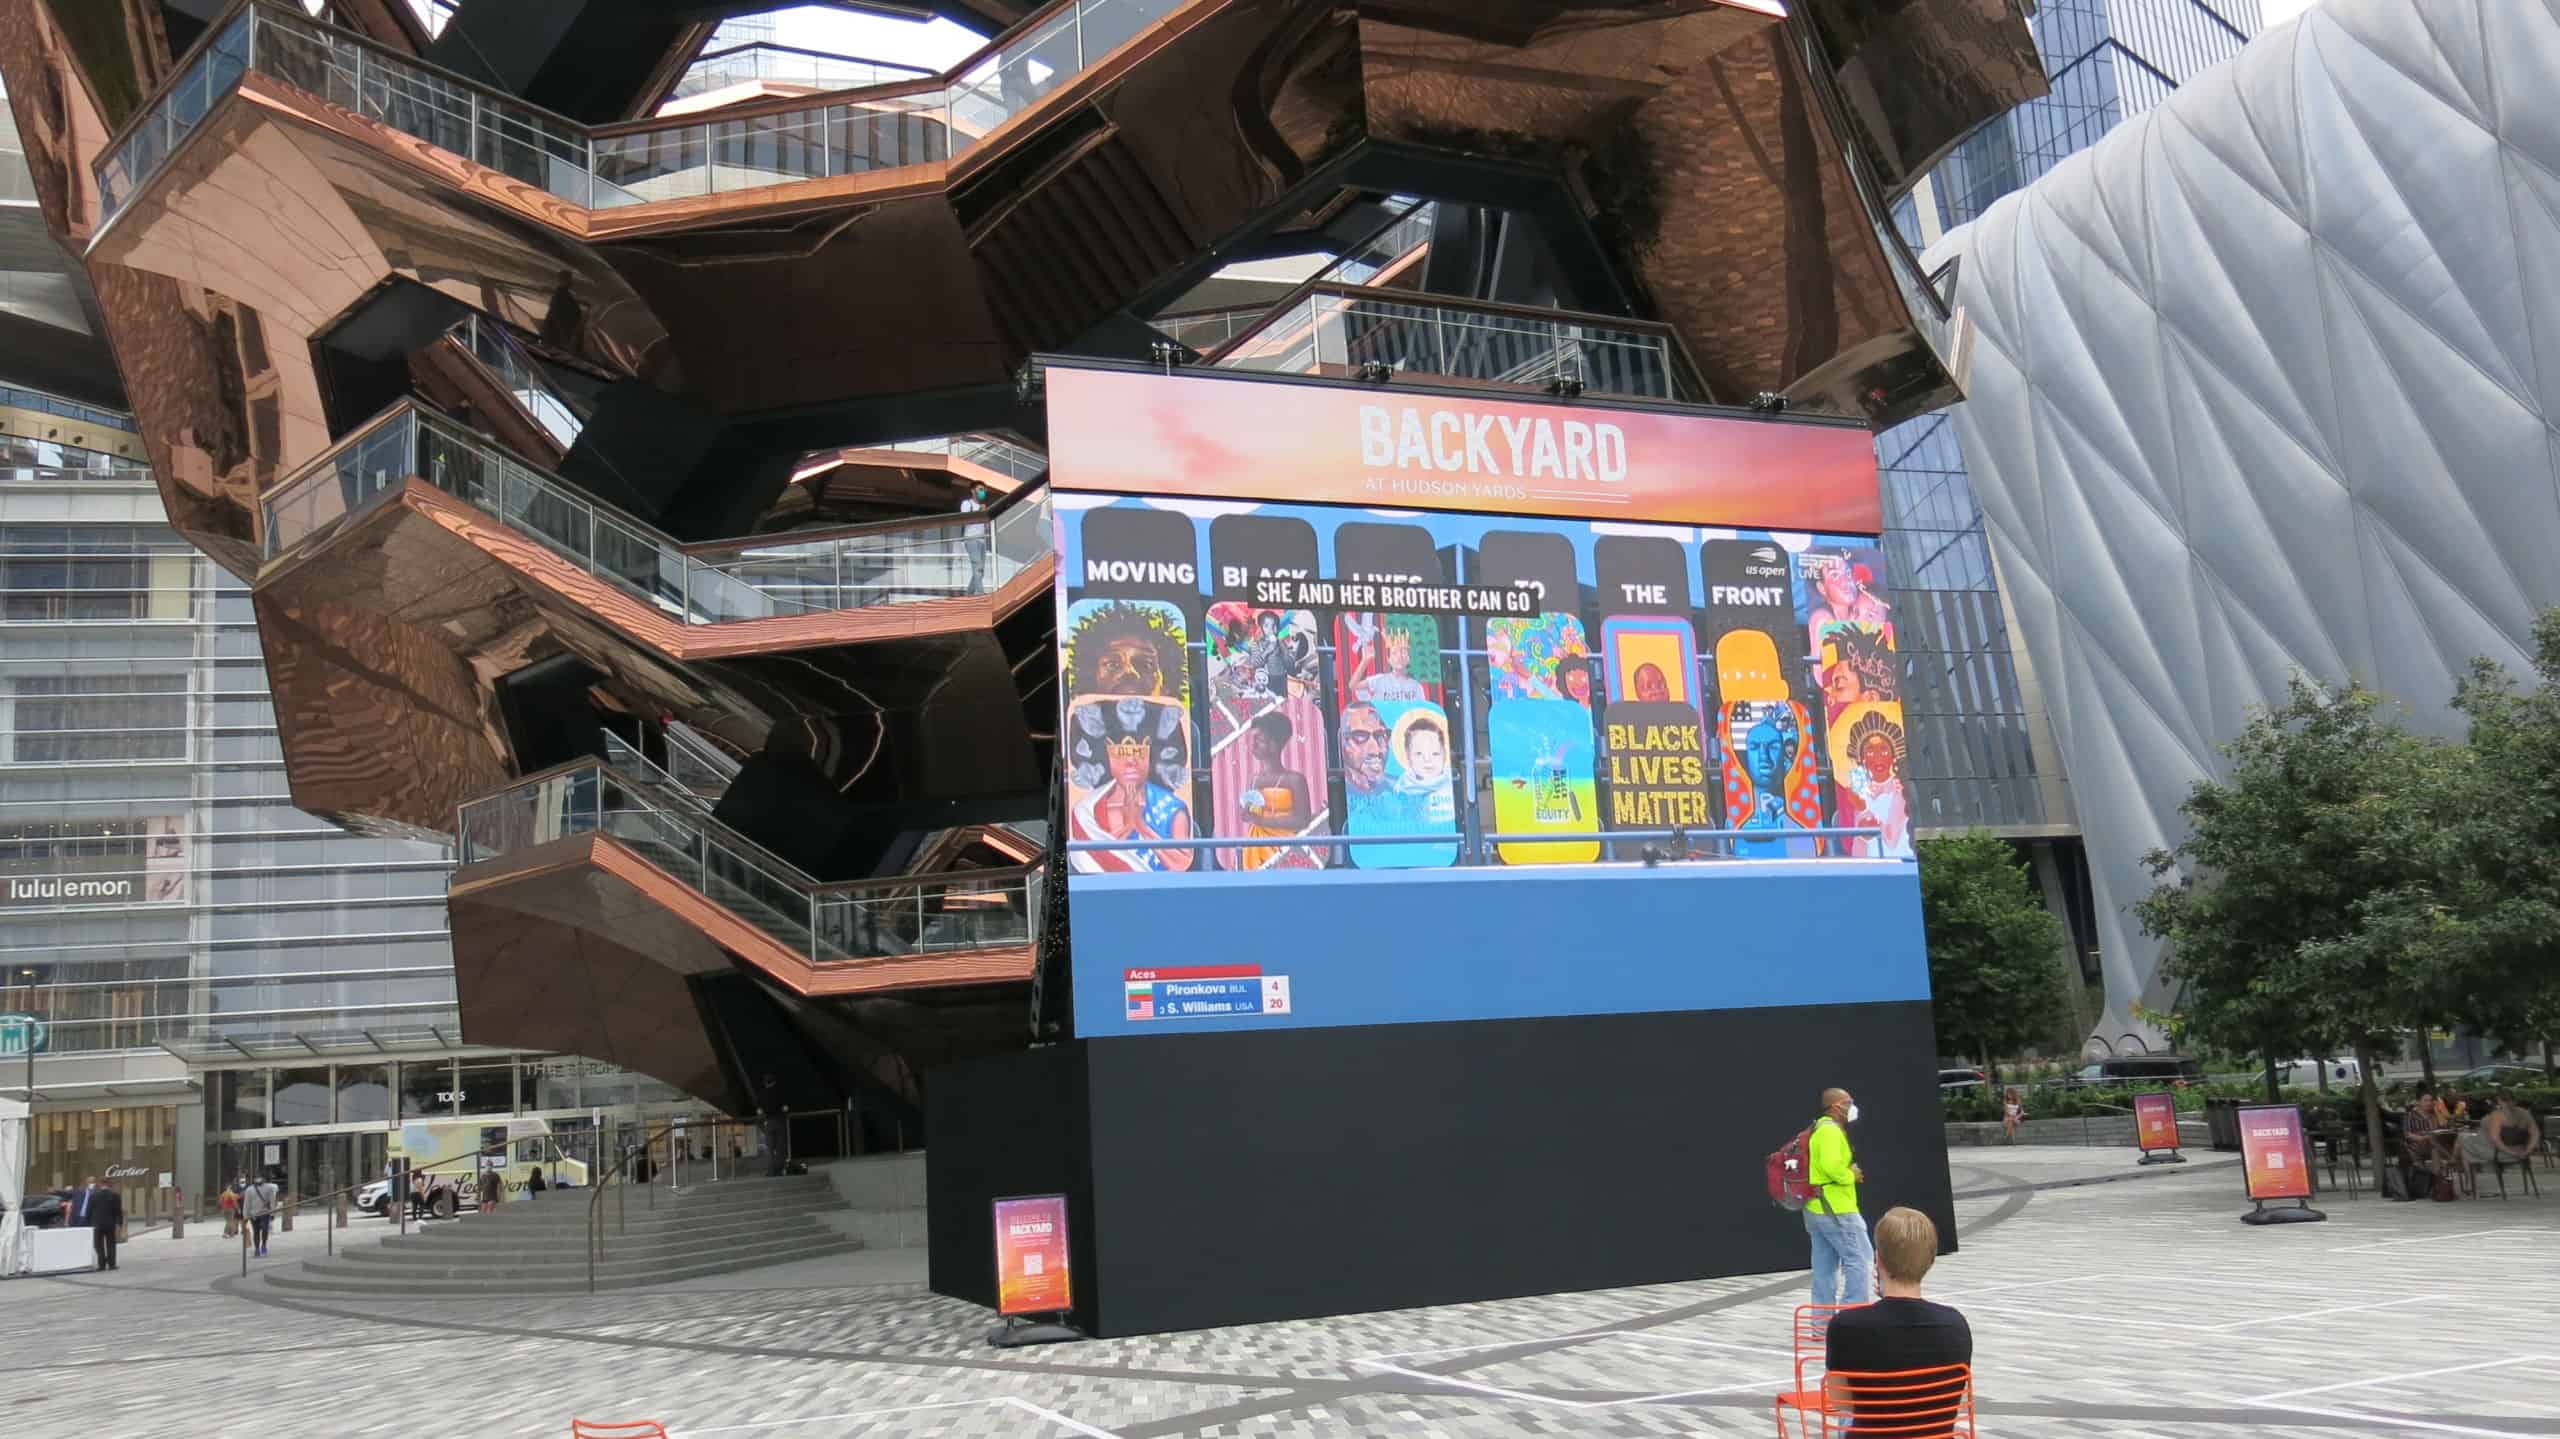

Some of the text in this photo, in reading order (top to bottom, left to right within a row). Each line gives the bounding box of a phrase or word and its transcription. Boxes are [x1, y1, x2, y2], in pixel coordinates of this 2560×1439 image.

[1359, 404, 1628, 482] BACKYARD
[1365, 477, 1528, 500] AT HUDSON YARDS
[1087, 560, 1195, 585] MOVING
[1761, 567, 1786, 579] open
[1256, 581, 1530, 612] SHE AND HER BROTHER CAN GO
[1621, 583, 1667, 604] THE
[1712, 586, 1784, 607] FRONT
[1608, 724, 1700, 751] BLACK
[1611, 755, 1703, 785] LIVES
[1613, 791, 1708, 825] MATTER
[10, 877, 131, 899] lululemon
[1129, 969, 1156, 980] Aces
[1166, 983, 1226, 996] Pironkova
[1271, 981, 1279, 991] 4
[1167, 1002, 1180, 1014] S.
[1182, 1001, 1233, 1013] Williams
[1235, 1003, 1254, 1012] USA
[1269, 999, 1283, 1009] 20
[105, 1164, 149, 1178] Cartier
